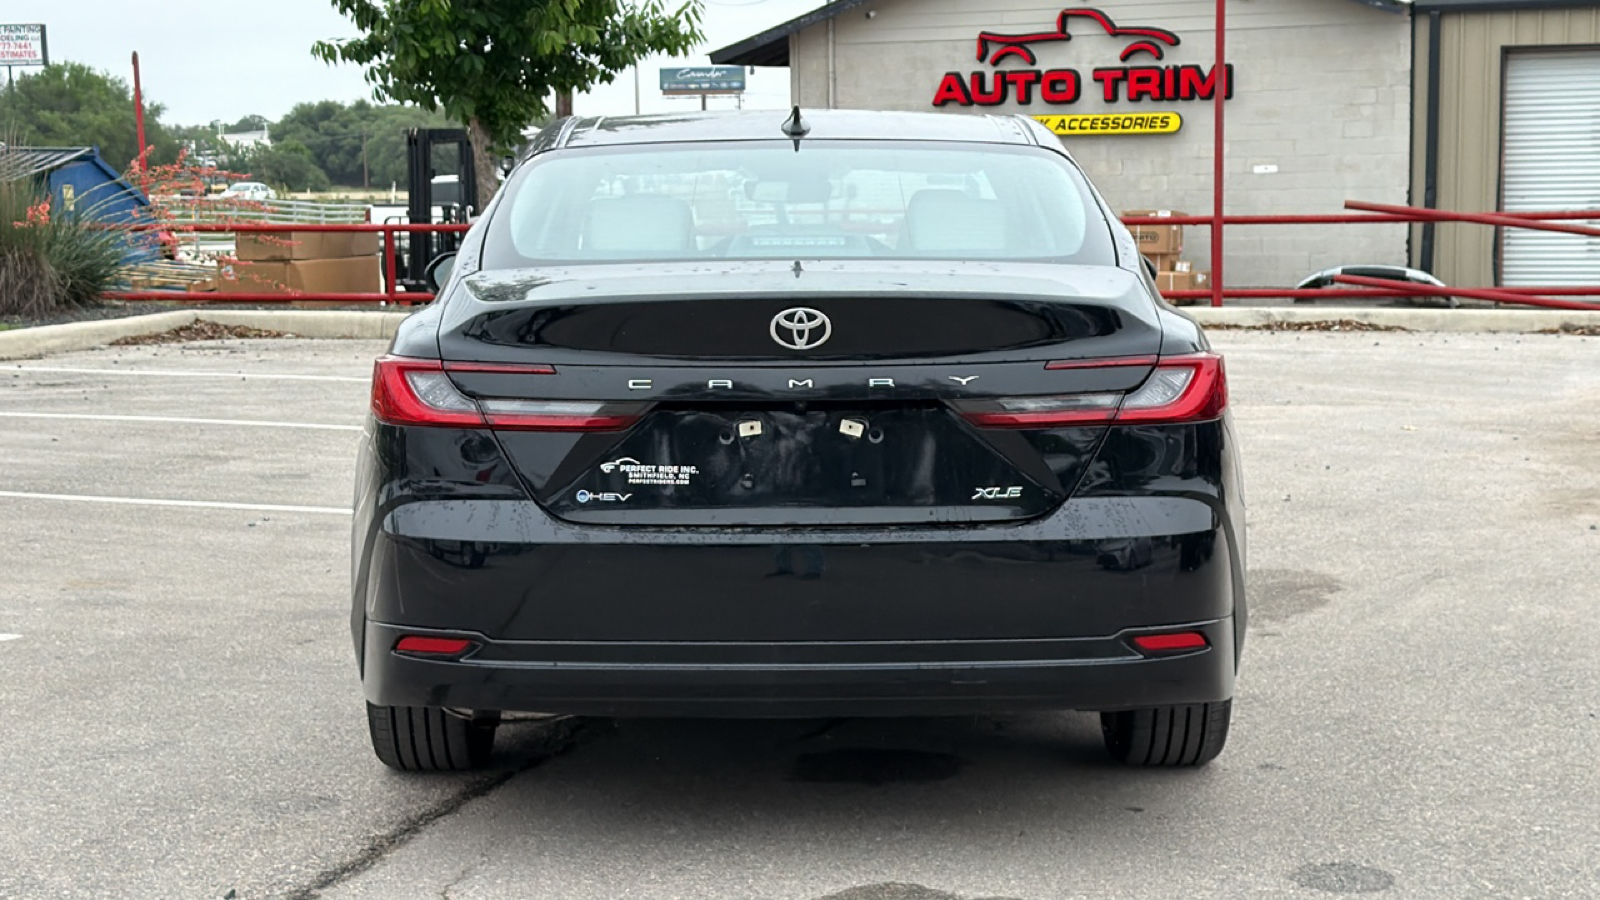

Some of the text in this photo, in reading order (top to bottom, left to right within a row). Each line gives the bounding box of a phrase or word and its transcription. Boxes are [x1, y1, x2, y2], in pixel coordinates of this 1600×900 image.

[0, 50, 37, 59] STIMATES
[933, 64, 1233, 106] AUTO TRIM
[1055, 115, 1171, 131] ACCESSORIES
[628, 374, 980, 390] CAMRY
[620, 465, 700, 475] PERFECT RIDE INC.
[589, 493, 633, 501] HEV
[971, 485, 1024, 500] XLE
